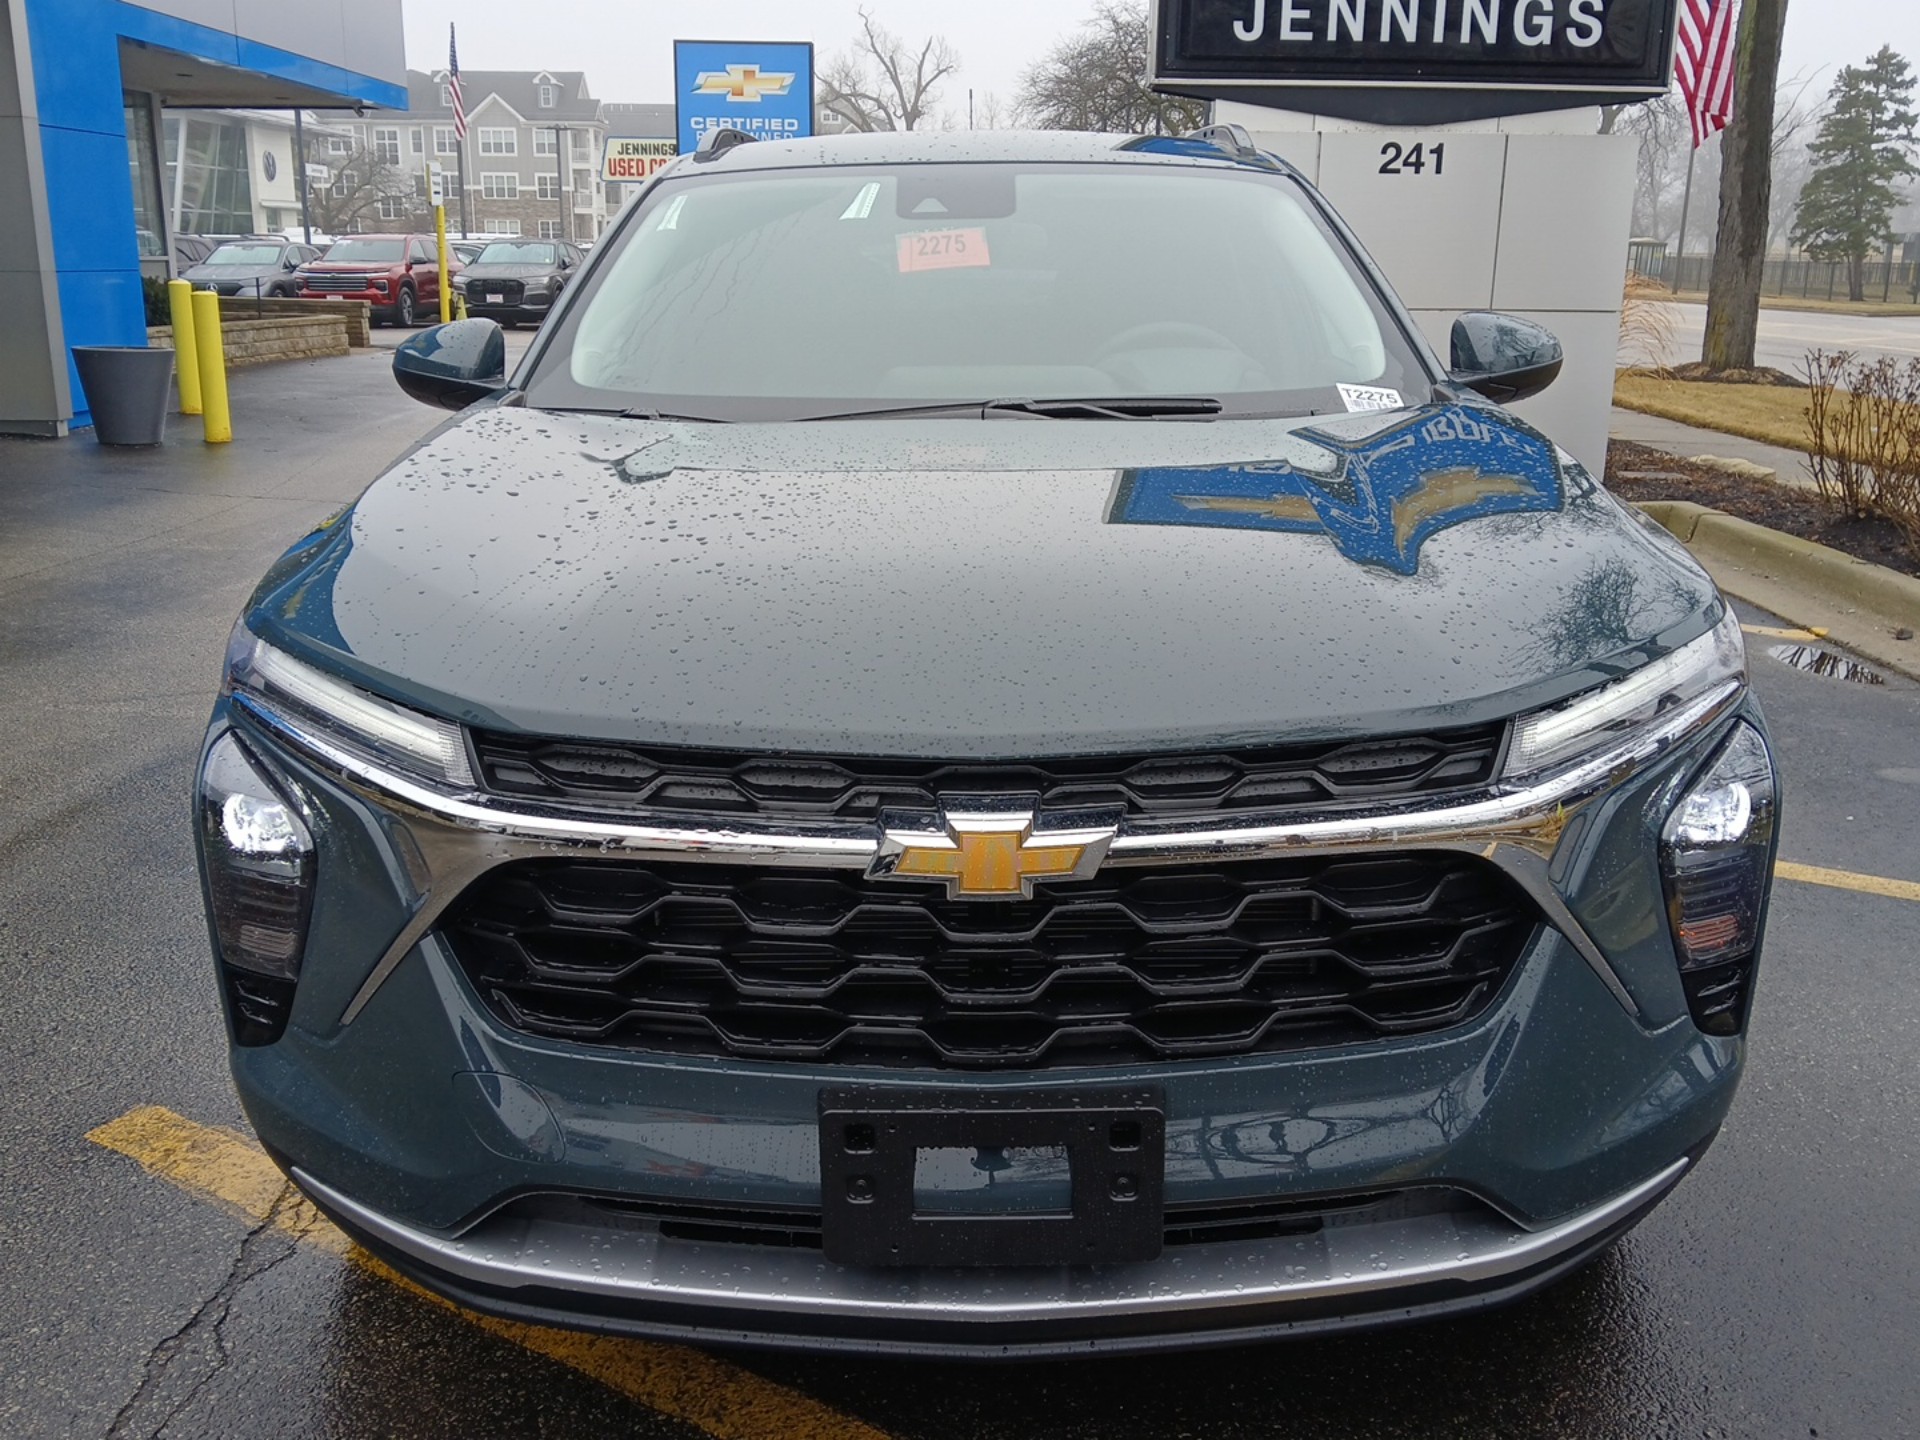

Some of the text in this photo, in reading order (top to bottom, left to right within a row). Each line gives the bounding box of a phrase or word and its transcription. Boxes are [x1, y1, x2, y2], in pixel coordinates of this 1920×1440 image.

[1232, 0, 1604, 48] JENNINGS
[690, 117, 799, 131] CERTIFIED
[608, 157, 645, 177] USED
[1378, 141, 1444, 175] 241
[917, 234, 966, 256] 2275
[1338, 386, 1398, 404] T2275
